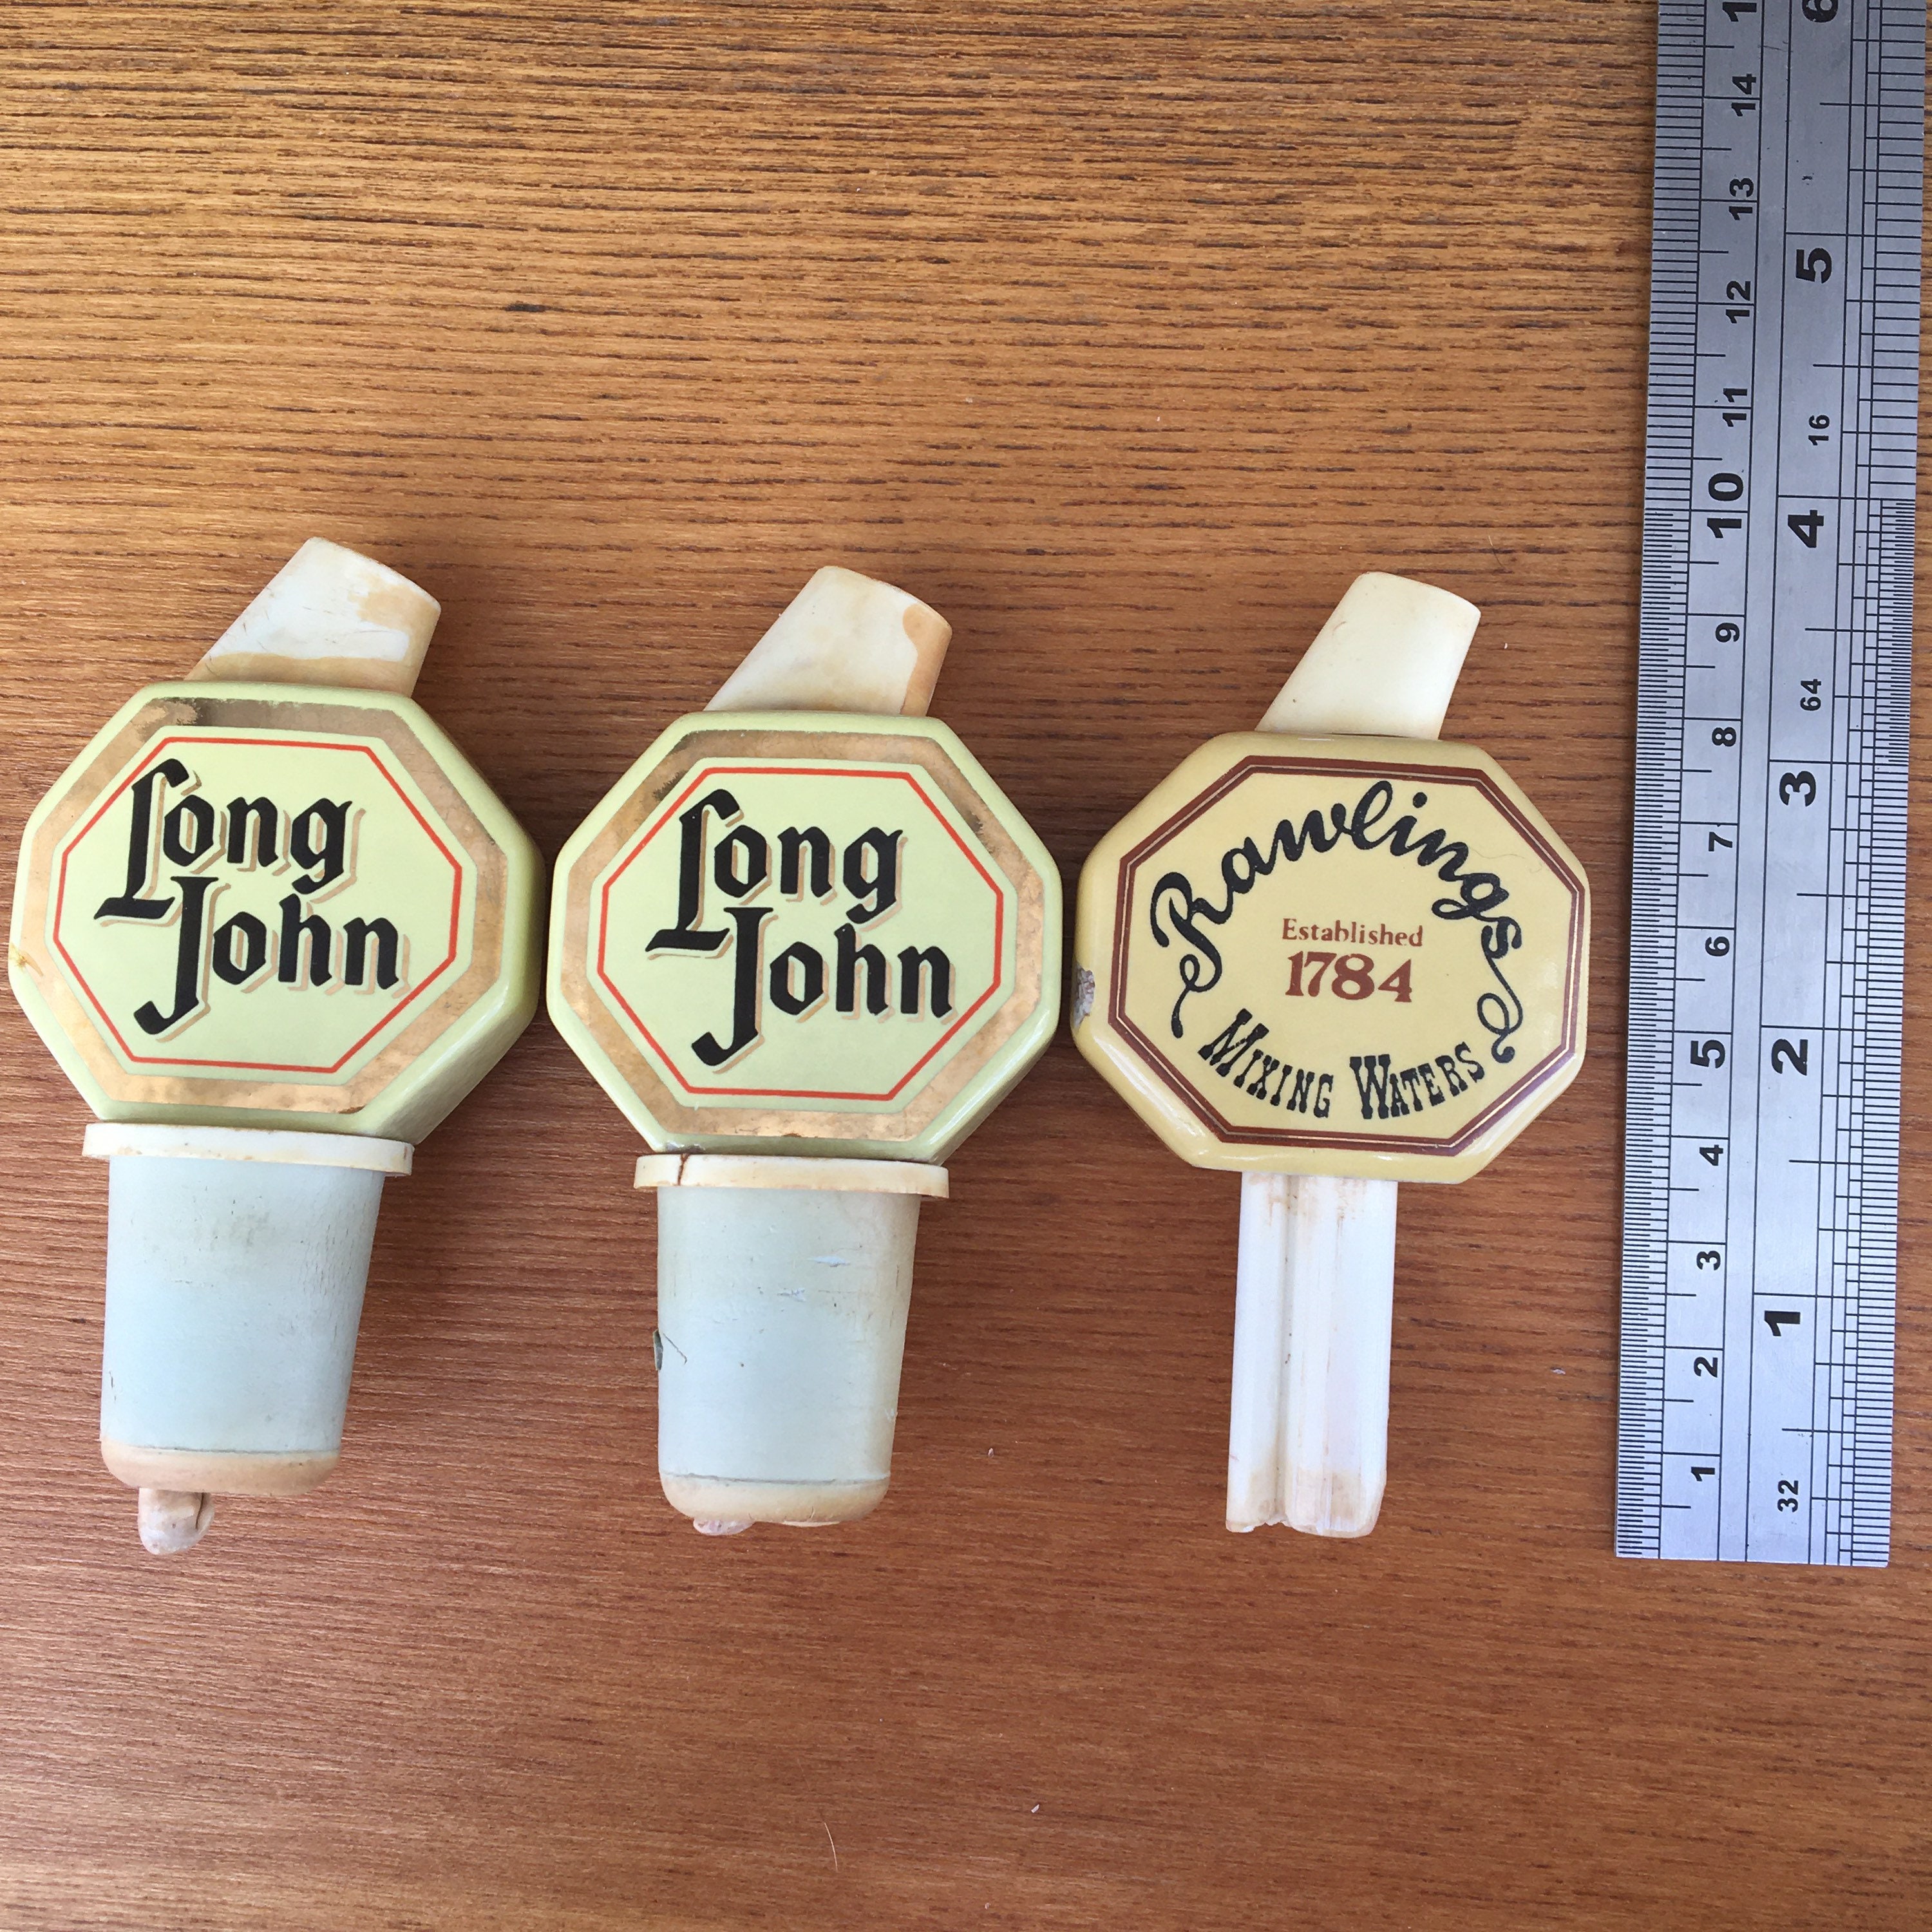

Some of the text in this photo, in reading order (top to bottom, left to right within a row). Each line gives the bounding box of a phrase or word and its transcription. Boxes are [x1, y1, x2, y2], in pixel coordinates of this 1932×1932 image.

[1796, 247, 1832, 284] 5
[1808, 413, 1830, 446] 16
[1787, 509, 1824, 548] 4
[1716, 623, 1739, 643] 9
[1800, 678, 1822, 711] 64
[1712, 726, 1736, 747] 8
[1779, 771, 1816, 806] 3
[94, 758, 353, 920] Long
[1709, 832, 1733, 852] 7
[647, 789, 903, 952] Long
[1150, 781, 1524, 1063] Rawlings
[1282, 918, 1423, 948] Established
[134, 875, 401, 1036] John
[1705, 936, 1730, 956] 6
[692, 907, 954, 1066] John
[1284, 951, 1413, 1003] 1784
[1197, 1008, 1486, 1120] MIXING WATERS
[1690, 1039, 1725, 1068] 5
[1772, 1038, 1808, 1075] 2
[1699, 1144, 1723, 1166] 4
[1696, 1251, 1721, 1270] 3
[1764, 1311, 1800, 1337] 1
[1694, 1356, 1718, 1377] 2
[1691, 1466, 1715, 1482] 1
[1777, 1479, 1799, 1513] 32
